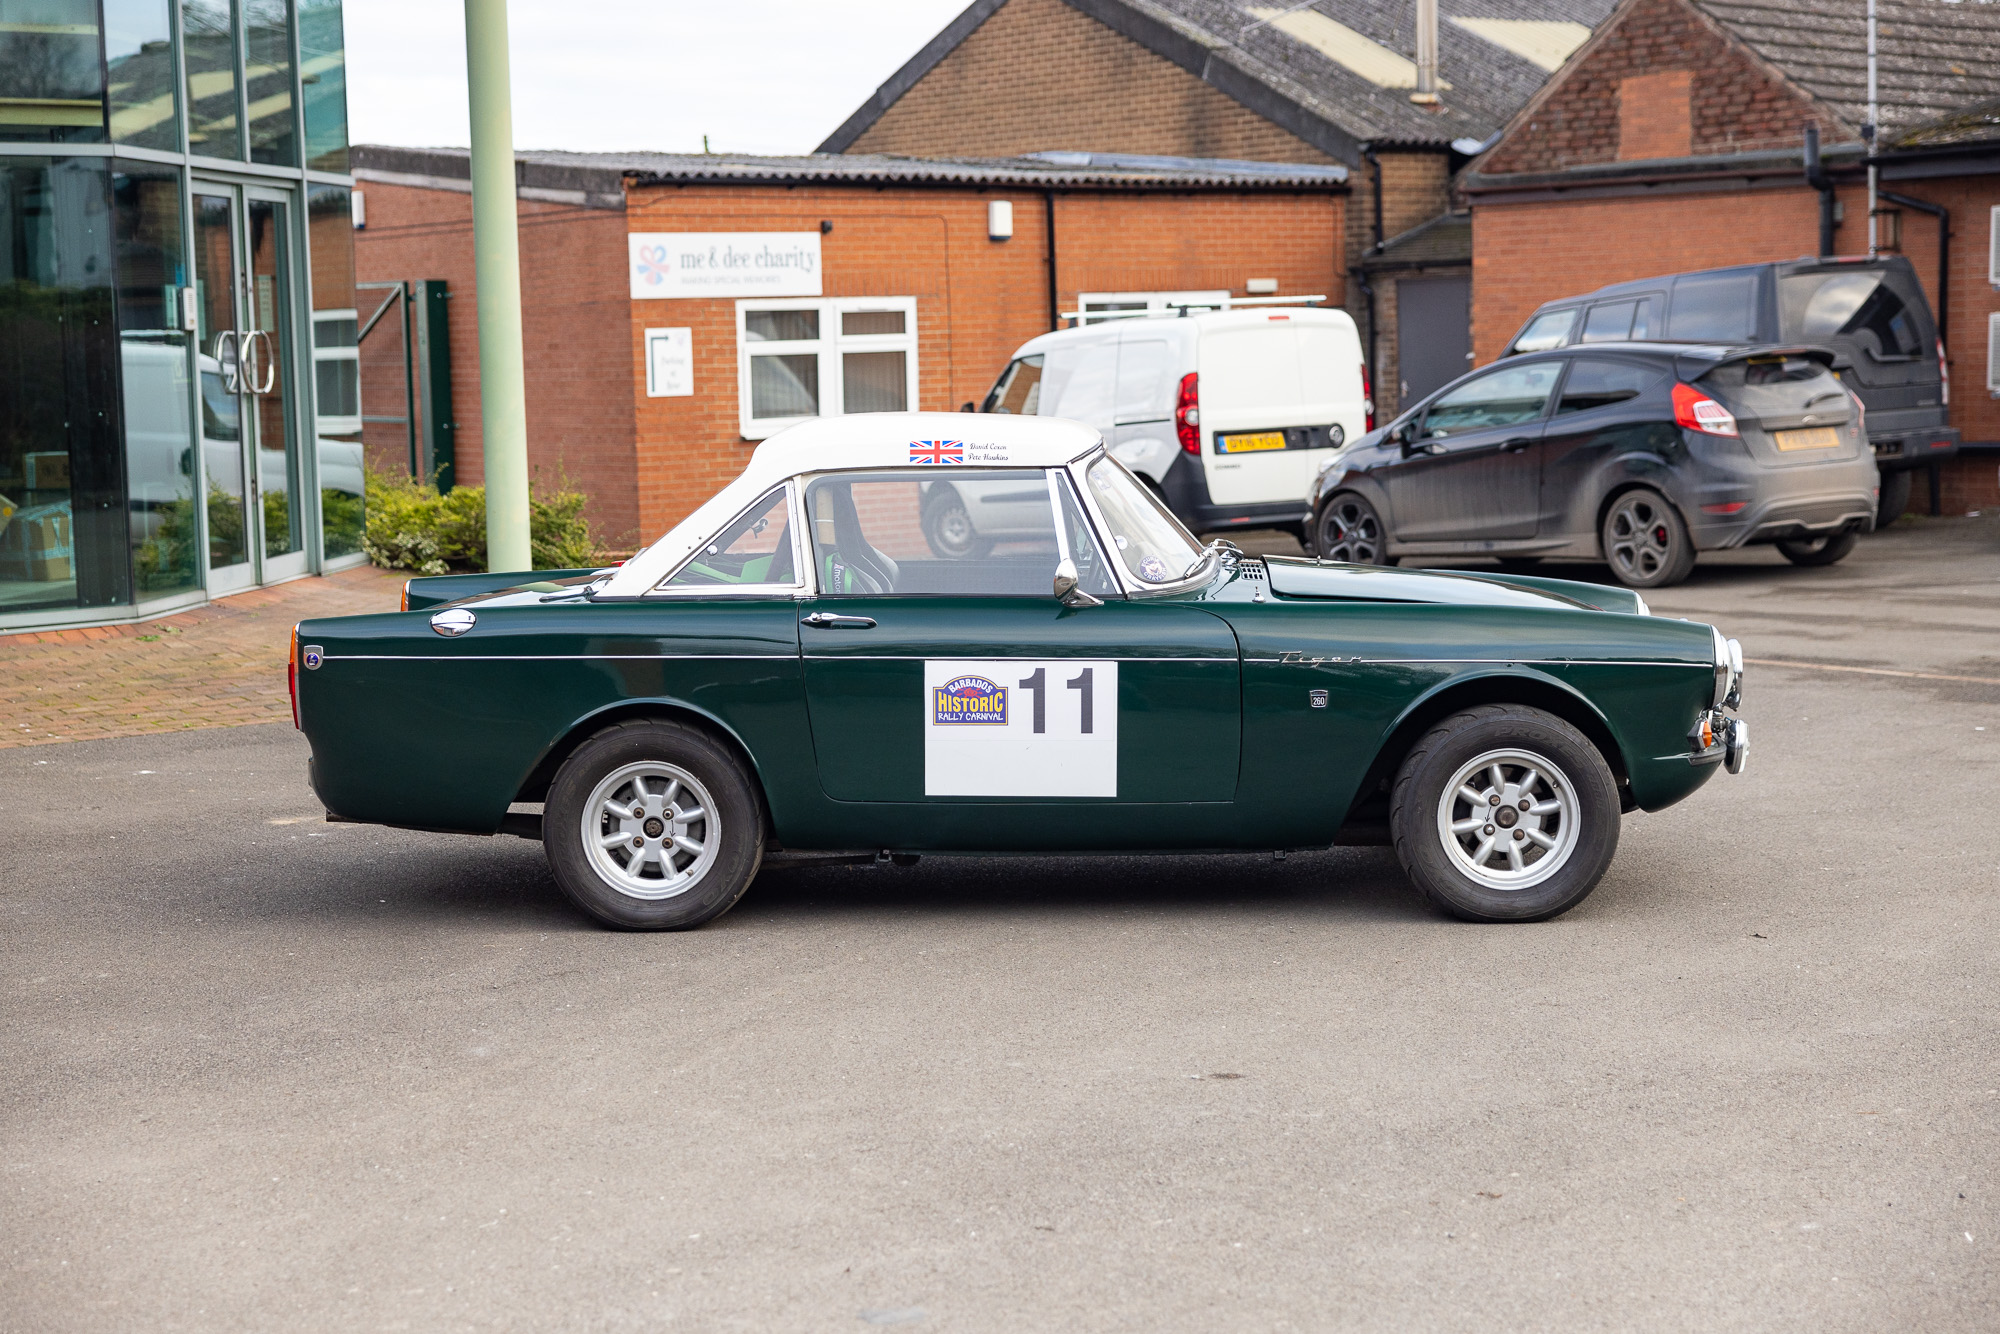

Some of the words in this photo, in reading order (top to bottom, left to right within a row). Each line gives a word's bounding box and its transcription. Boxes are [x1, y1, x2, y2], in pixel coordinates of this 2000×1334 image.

[681, 252, 705, 269] me
[708, 246, 719, 269] &
[723, 245, 750, 269] dee
[755, 245, 815, 273] charity
[968, 453, 981, 461] Pete
[1279, 650, 1362, 668] Tiger
[948, 678, 994, 693] BARBADOS
[938, 691, 1004, 712] HISTORIC
[1018, 667, 1094, 734] 11
[1312, 696, 1325, 706] 260
[938, 712, 964, 721] RALLY
[965, 712, 1004, 721] CARNIVAL
